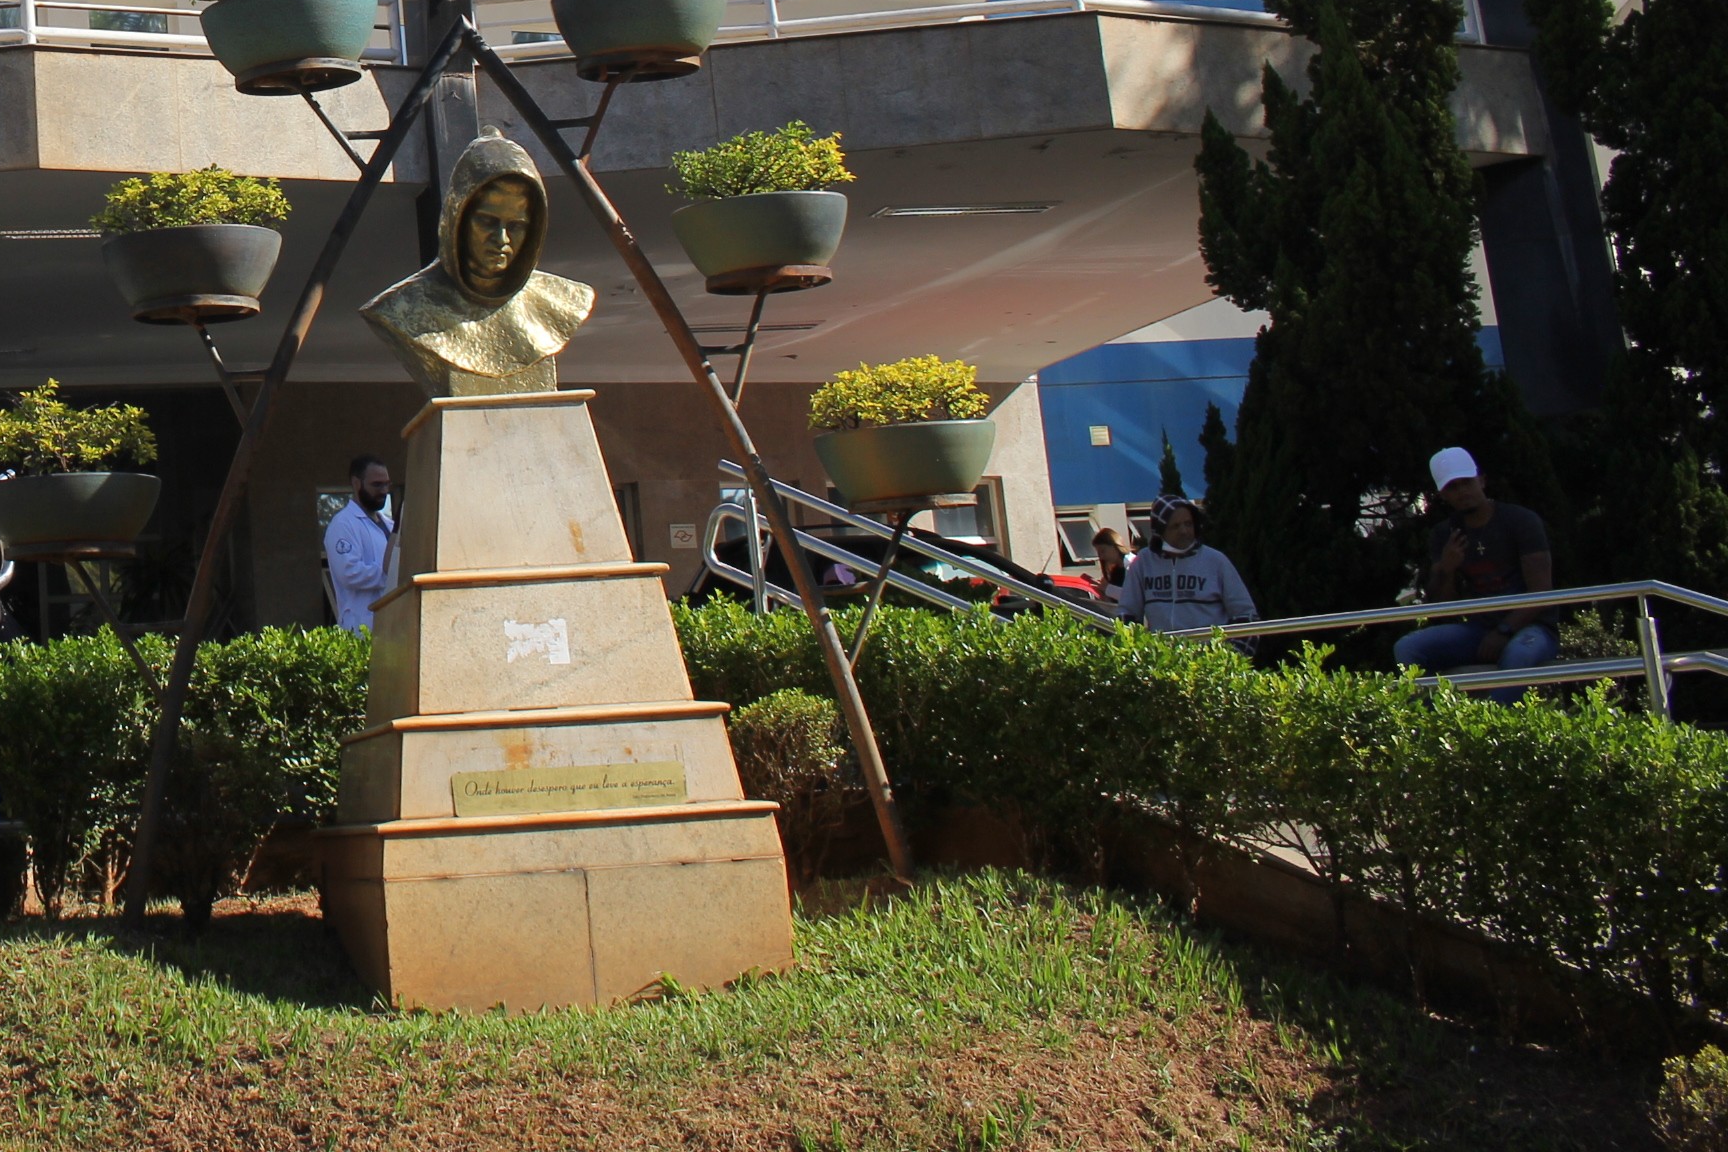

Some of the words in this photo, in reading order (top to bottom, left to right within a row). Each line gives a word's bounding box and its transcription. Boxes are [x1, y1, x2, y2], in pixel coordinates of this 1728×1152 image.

[1145, 574, 1207, 591] NOBODY
[464, 780, 492, 797] Onde
[495, 780, 524, 795] houver
[527, 779, 568, 796] desespero
[570, 785, 585, 795] que
[602, 773, 618, 789] leve
